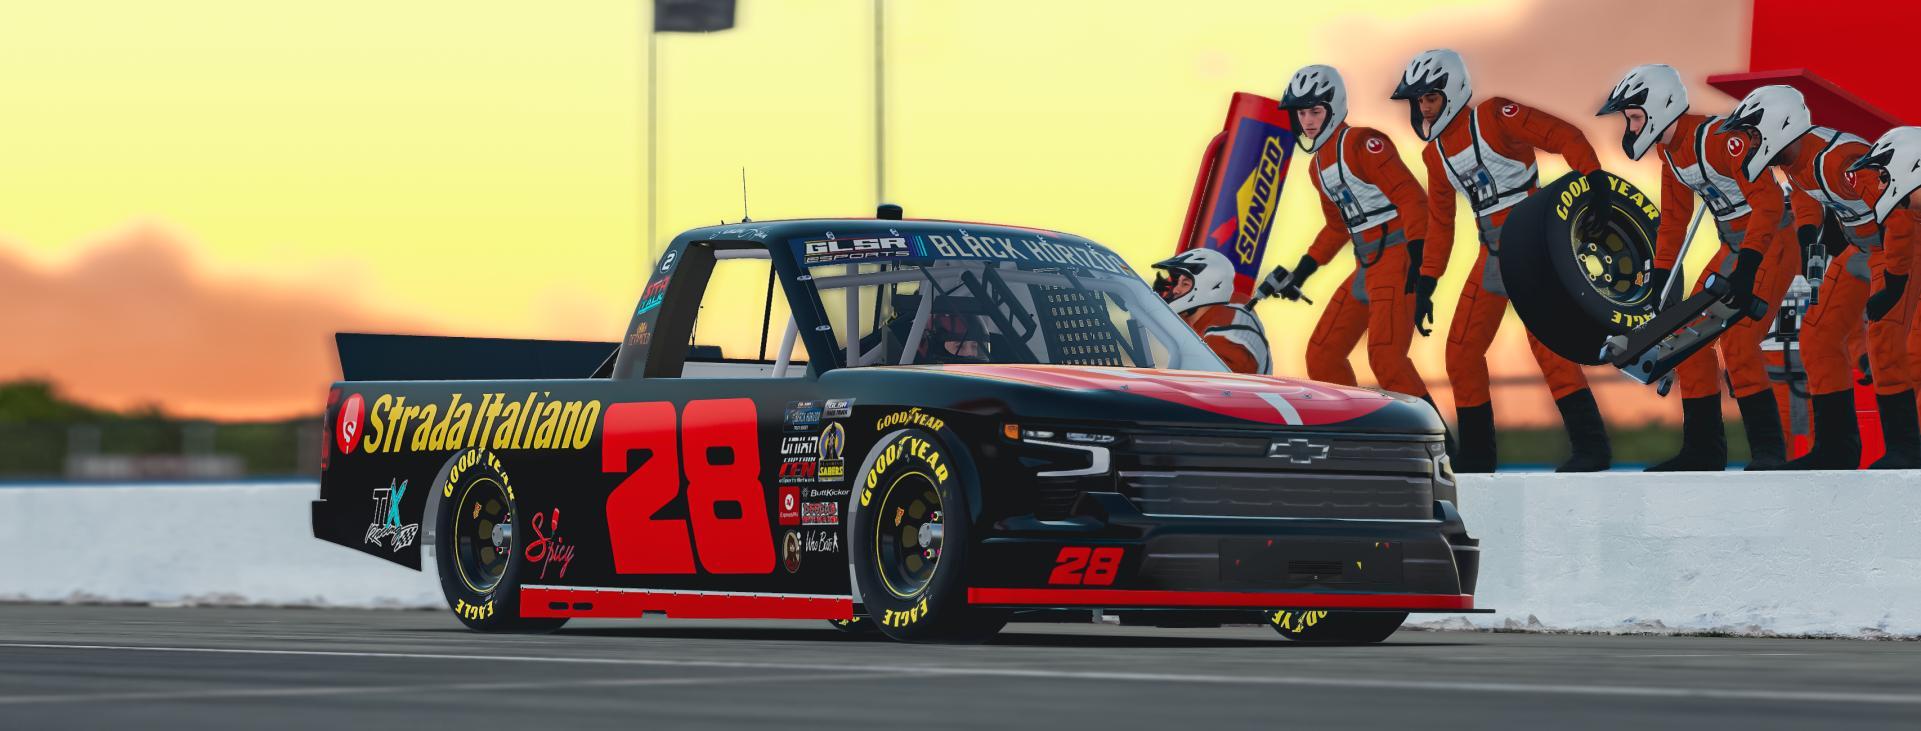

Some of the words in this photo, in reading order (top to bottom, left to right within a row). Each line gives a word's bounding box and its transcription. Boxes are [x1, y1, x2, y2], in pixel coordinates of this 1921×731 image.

[1237, 138, 1282, 263] SUNOCO
[805, 237, 908, 254] GLSR
[805, 251, 910, 264] ESPORTS
[928, 234, 1029, 260] BLACK
[661, 251, 676, 271] 2
[1611, 310, 1656, 327] AGLE
[602, 398, 776, 574] 28
[810, 487, 849, 497] ButtKicker
[525, 511, 575, 580] Spicy
[1048, 546, 1125, 586] 28
[455, 599, 494, 621] EAGLE
[882, 597, 929, 628] EAGLE
